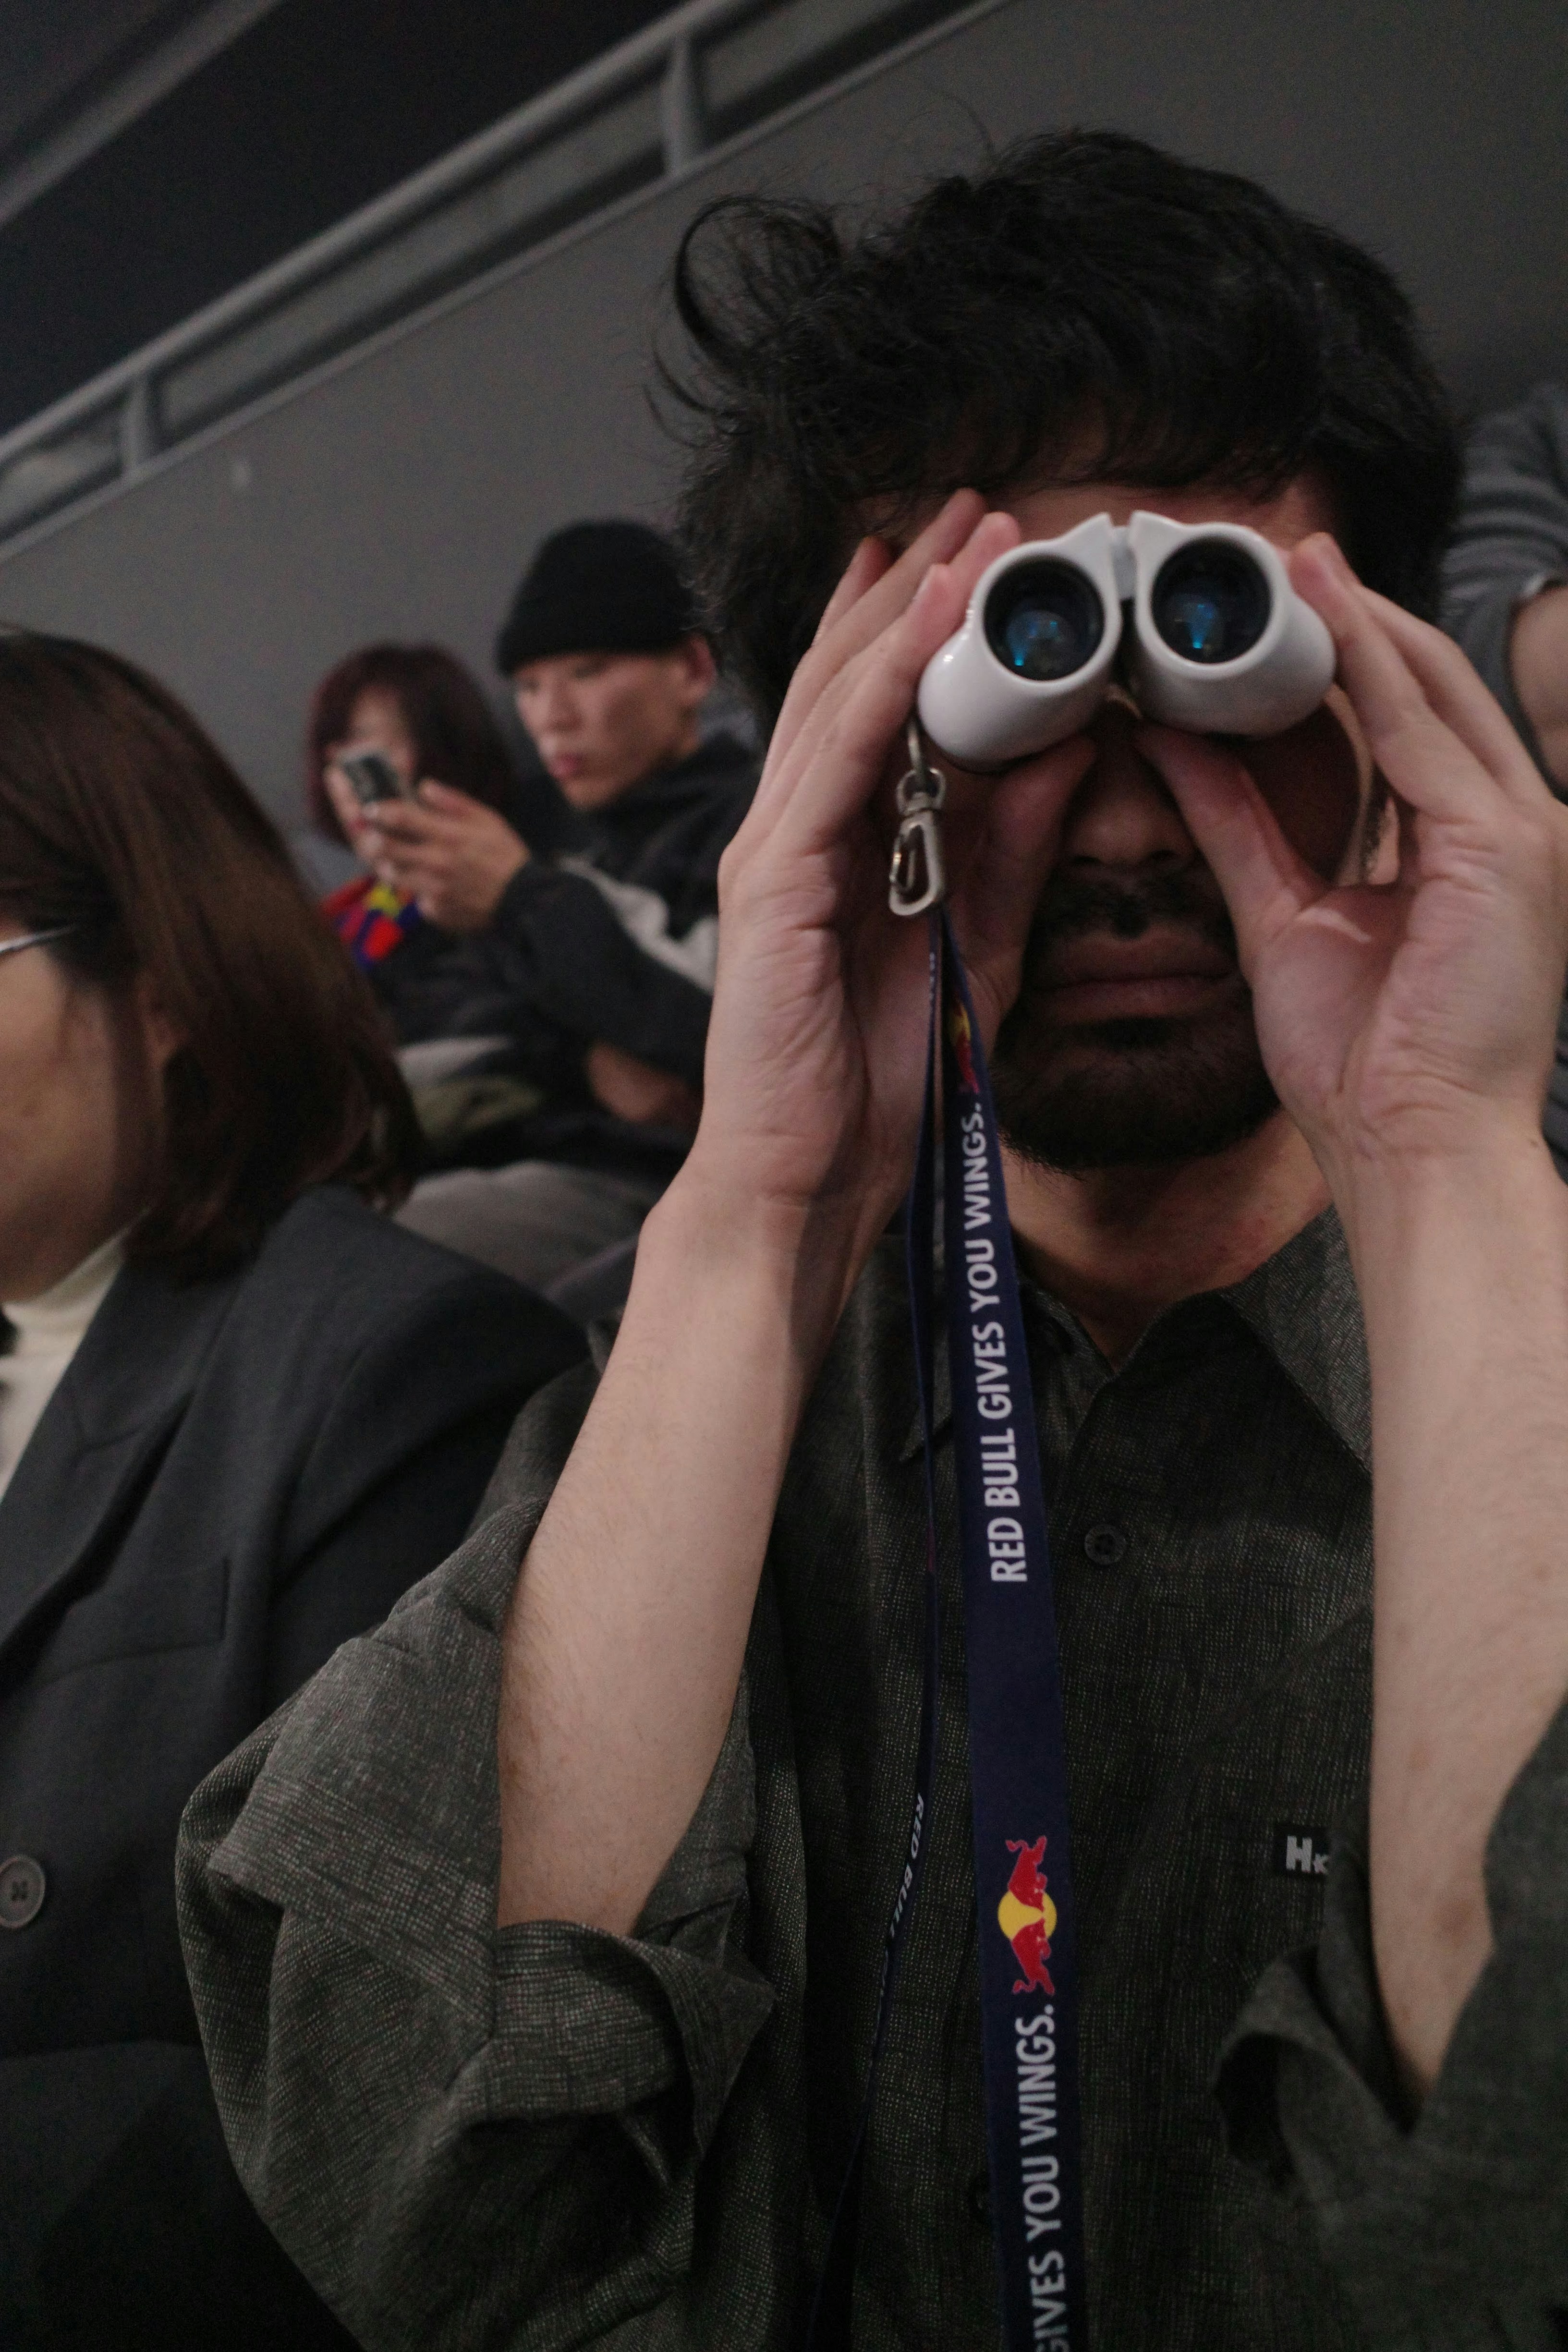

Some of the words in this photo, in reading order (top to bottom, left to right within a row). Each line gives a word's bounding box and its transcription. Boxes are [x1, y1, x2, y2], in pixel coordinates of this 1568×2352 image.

[961, 1103, 991, 1231] WINGS.
[964, 1238, 1001, 1312] YOU
[972, 1321, 1012, 1419] GIVES
[981, 1428, 1021, 1507] BULL
[987, 1517, 1028, 1582] RED
[911, 1792, 924, 1860] RED
[1015, 2003, 1057, 2147] WINGS.
[1021, 2156, 1061, 2242] YOU
